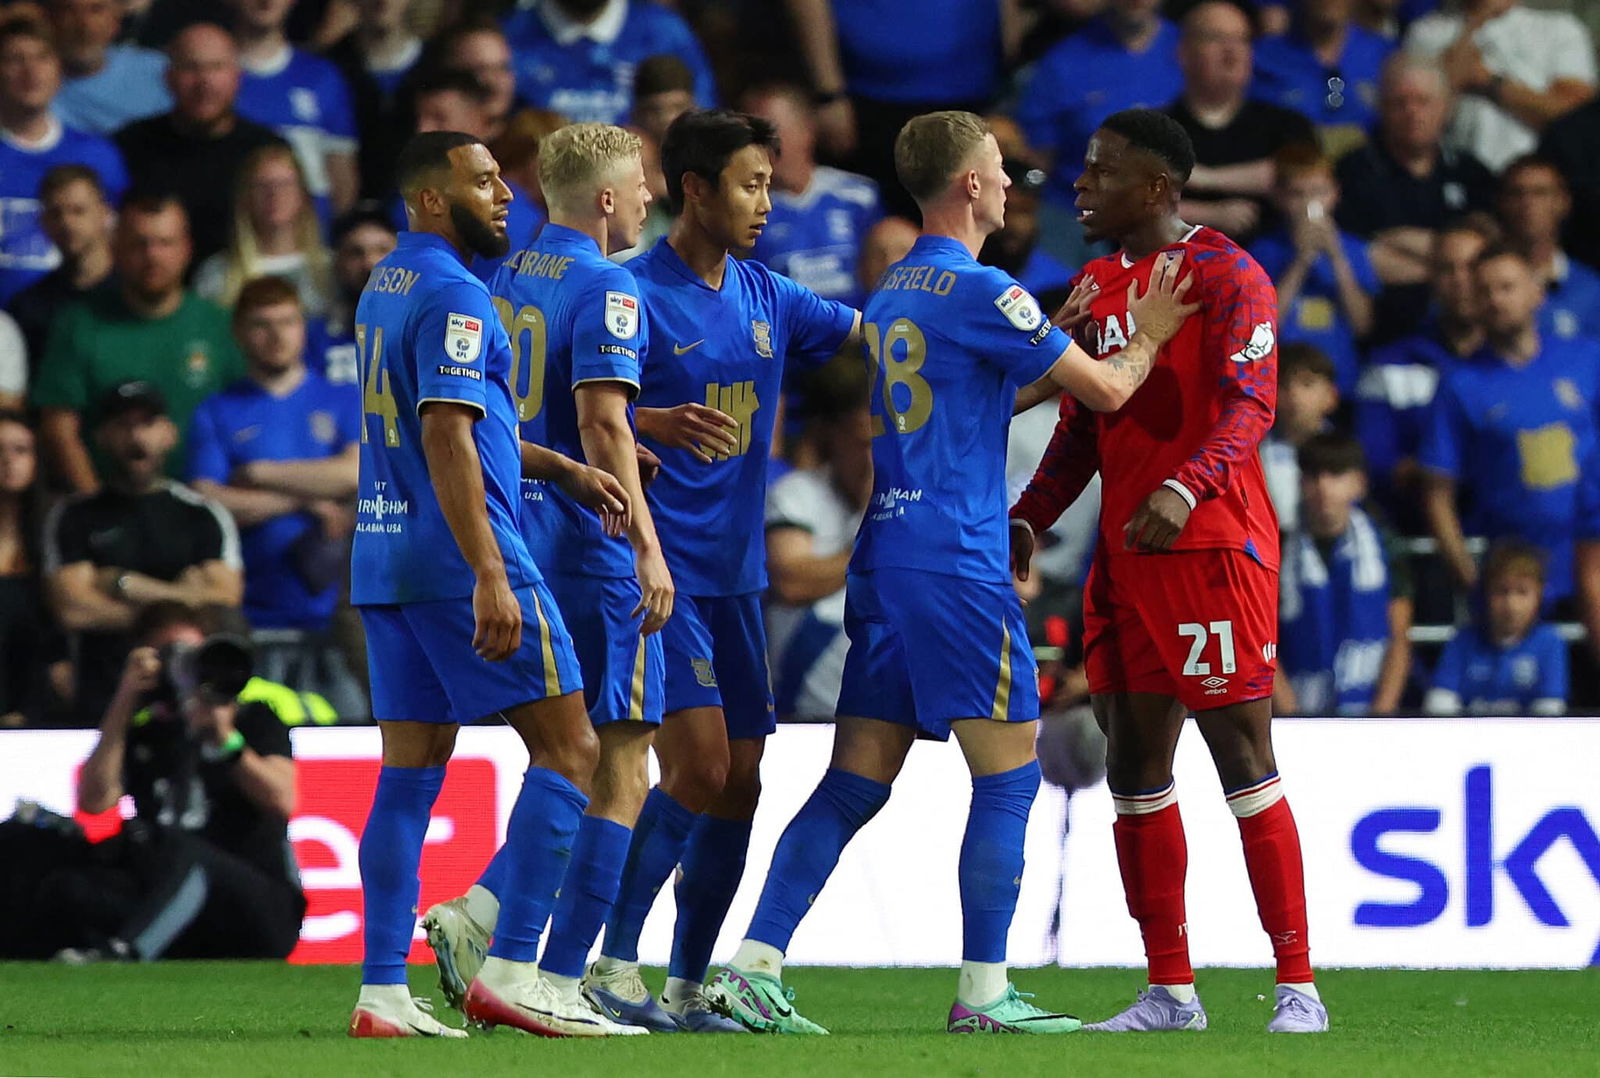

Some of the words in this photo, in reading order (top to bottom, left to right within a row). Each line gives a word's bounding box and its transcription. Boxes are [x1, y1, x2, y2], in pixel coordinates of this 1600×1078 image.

[492, 296, 547, 422] 0
[439, 365, 481, 381] TOGETHER
[524, 491, 543, 502] USA
[386, 523, 402, 534] USA
[1178, 620, 1237, 676] 21
[1204, 687, 1228, 696] umbro
